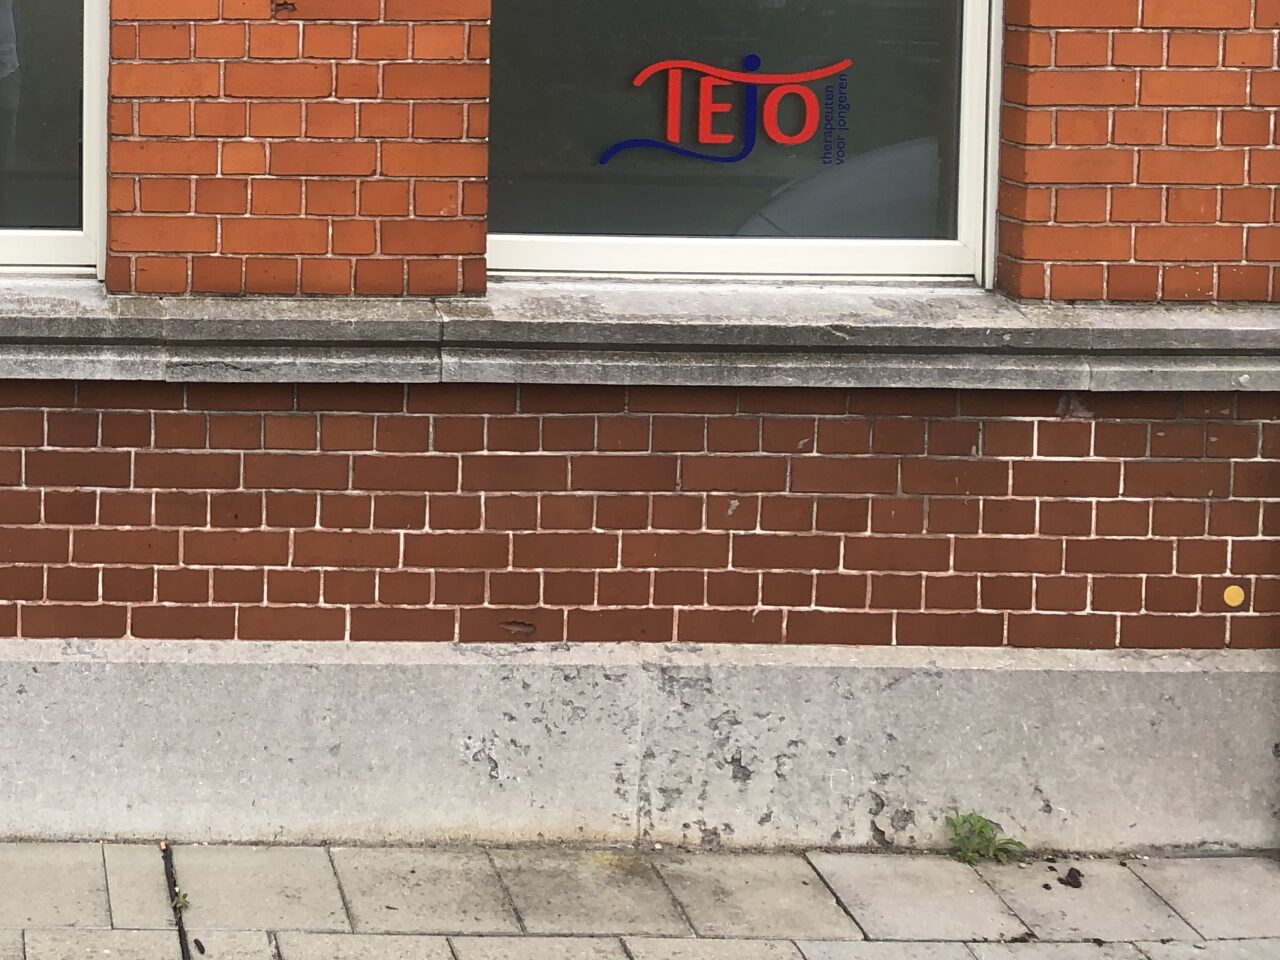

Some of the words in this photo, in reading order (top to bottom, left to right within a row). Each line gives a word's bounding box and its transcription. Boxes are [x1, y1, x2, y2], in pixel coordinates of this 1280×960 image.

[821, 85, 836, 165] therapeuten
[838, 73, 850, 130] jongeren
[836, 135, 846, 166] voor
